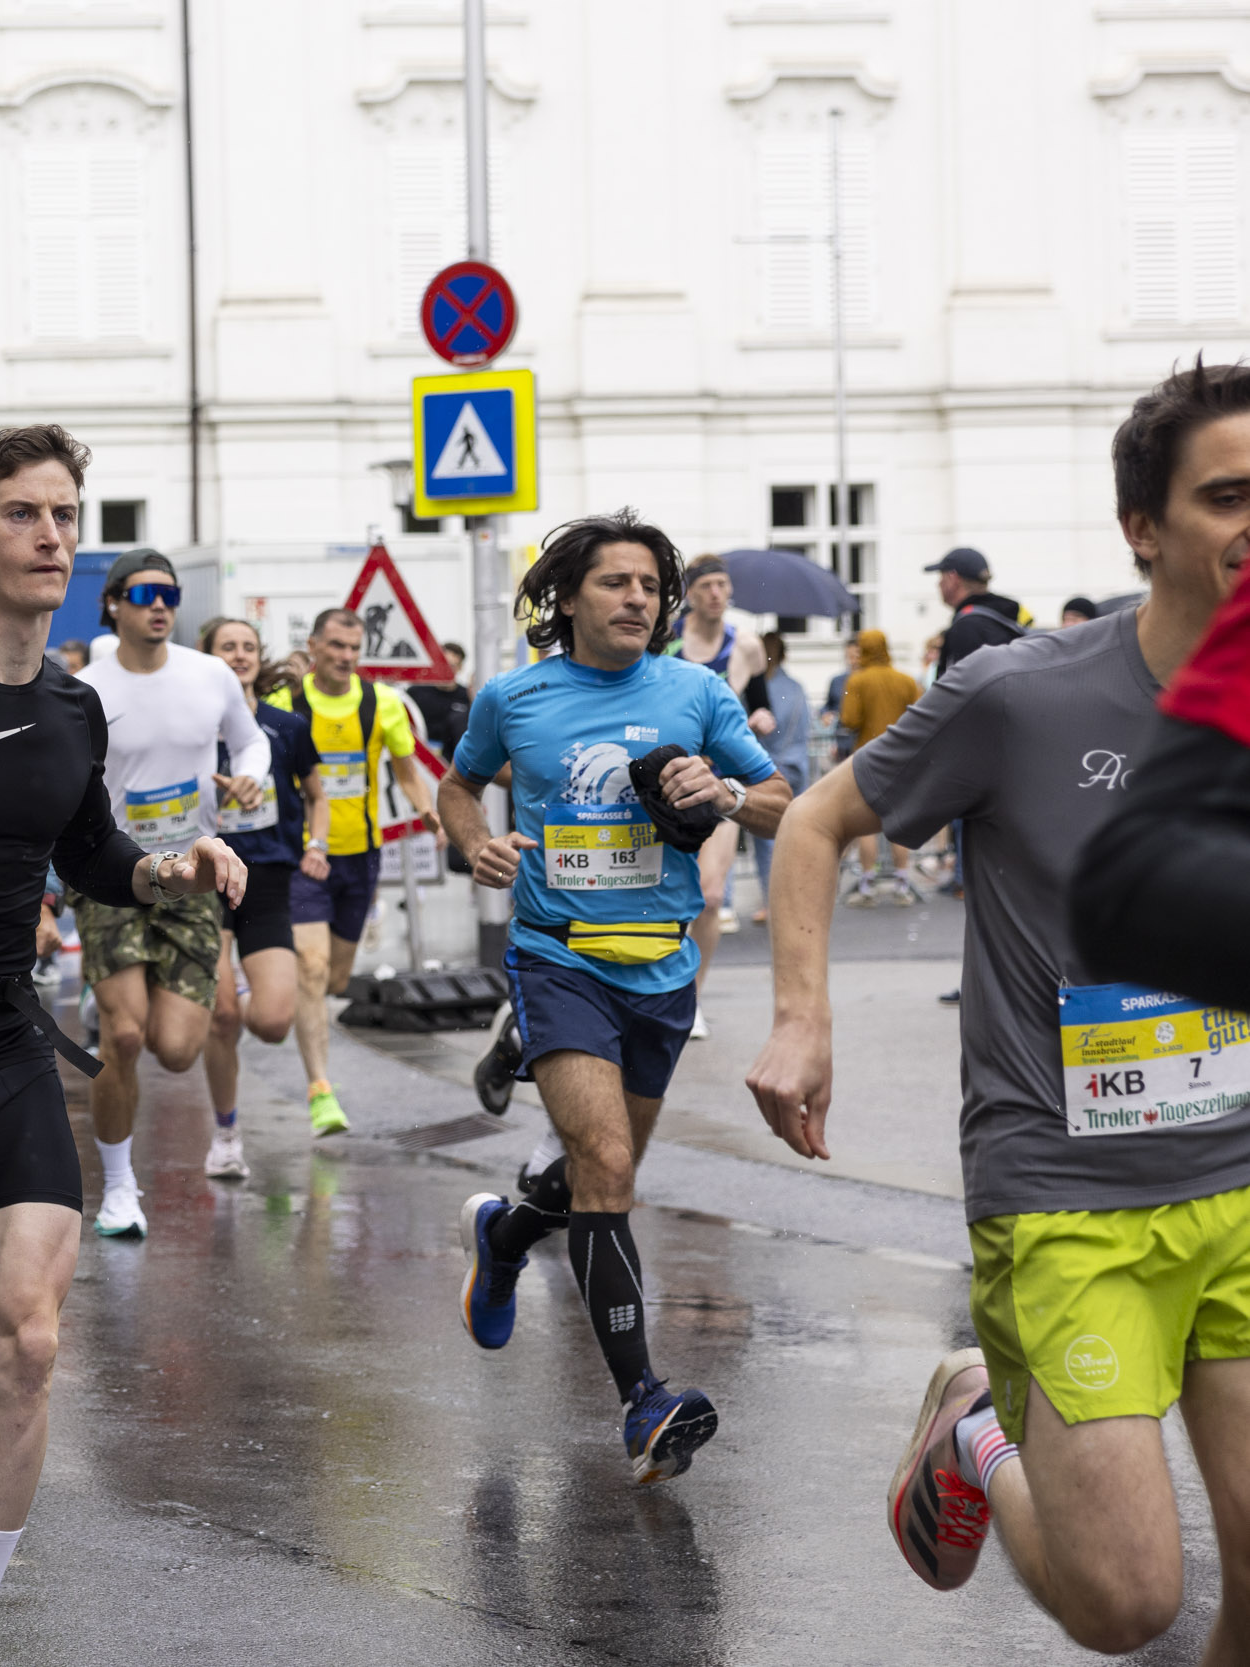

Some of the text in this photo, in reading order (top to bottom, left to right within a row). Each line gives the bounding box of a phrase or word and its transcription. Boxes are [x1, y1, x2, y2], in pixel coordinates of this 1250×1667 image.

[508, 684, 538, 702] luanvi
[577, 811, 622, 820] SPARKASSE
[628, 823, 653, 837] tut
[611, 851, 636, 864] 163
[554, 872, 658, 887] Tiroler Tageszeitung
[1095, 1036, 1137, 1048] stadtlauf
[1082, 1046, 1126, 1056] innsbruck
[1189, 1057, 1202, 1078] 7
[1083, 1108, 1142, 1128] Tiroler
[611, 1321, 636, 1333] cep
